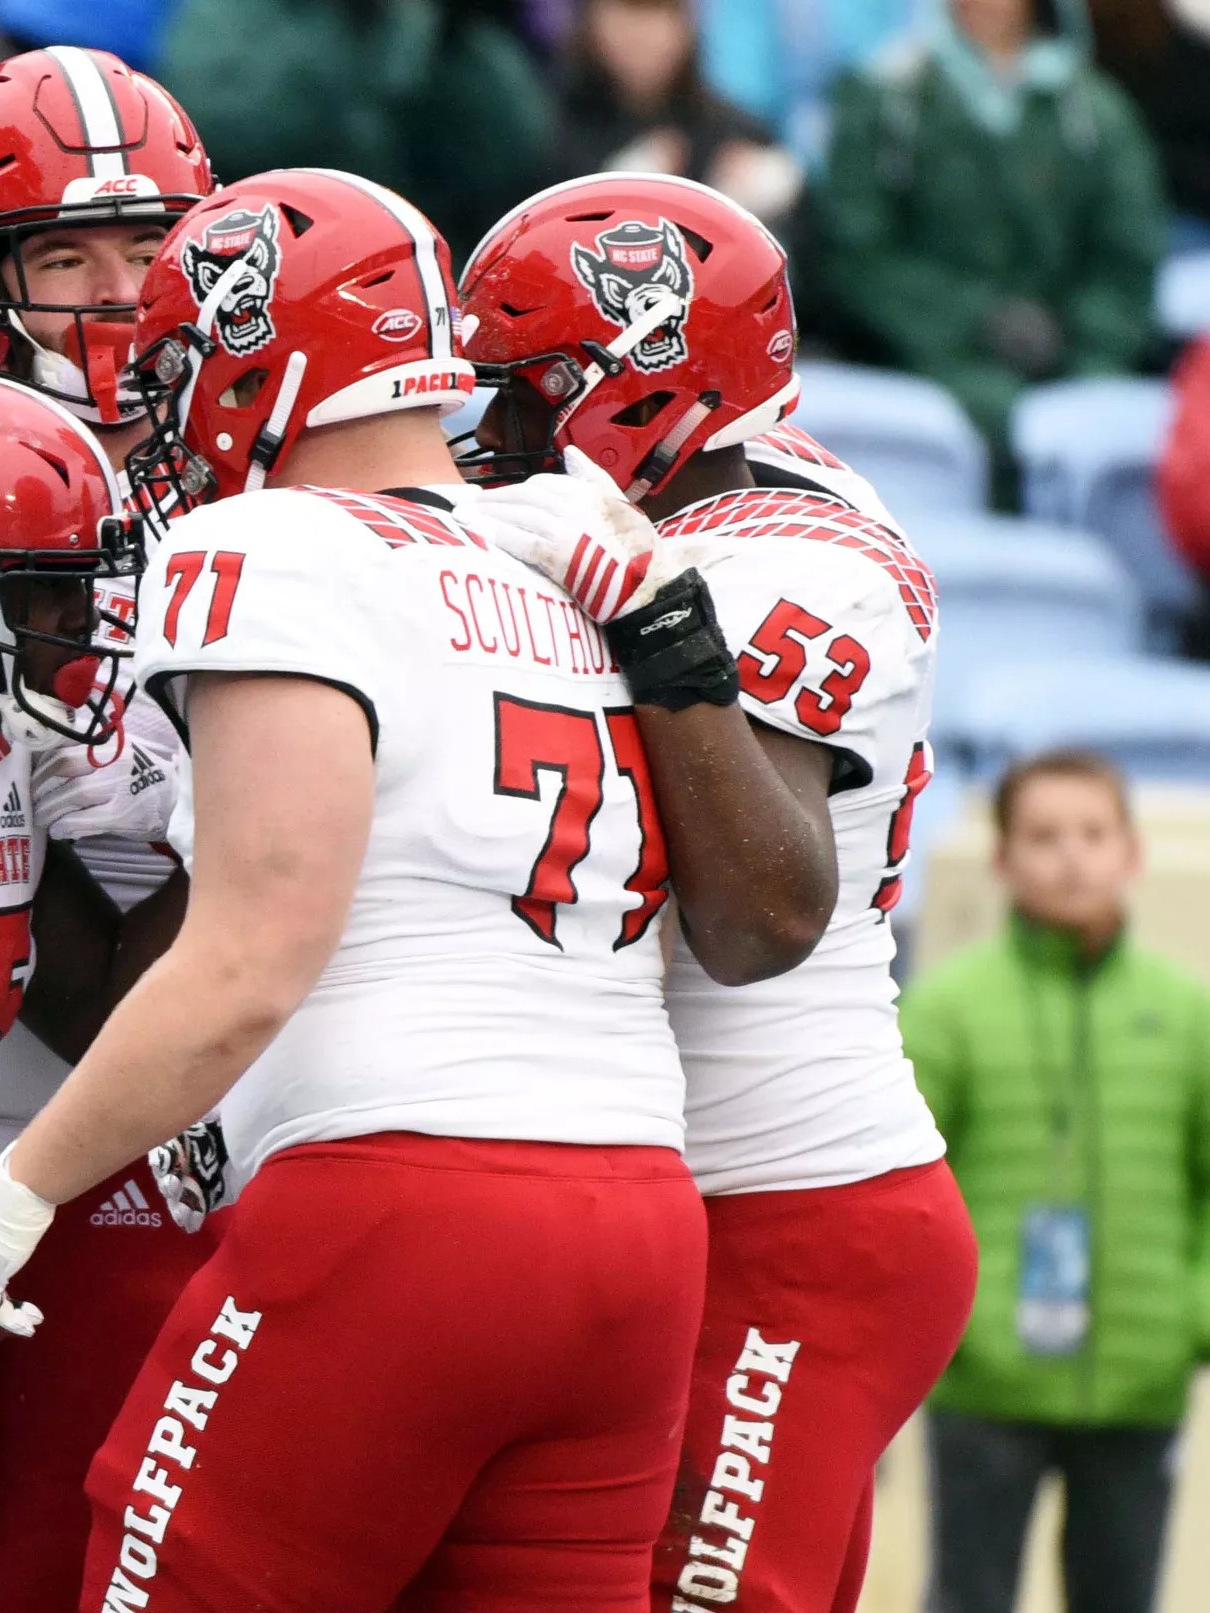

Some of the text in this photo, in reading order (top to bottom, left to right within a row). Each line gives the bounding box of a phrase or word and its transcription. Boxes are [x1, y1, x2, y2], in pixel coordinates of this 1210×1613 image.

[94, 178, 140, 194] ACC
[612, 248, 658, 263] NC STATE
[378, 312, 415, 333] ACC
[163, 550, 247, 650] 71
[736, 597, 871, 737] 53
[130, 769, 166, 795] adidas
[0, 814, 26, 829] adidas
[493, 690, 669, 952] 71
[91, 1209, 163, 1228] adidas
[101, 1296, 263, 1613] WOLFPACK
[671, 1327, 801, 1613] OLFPACK
